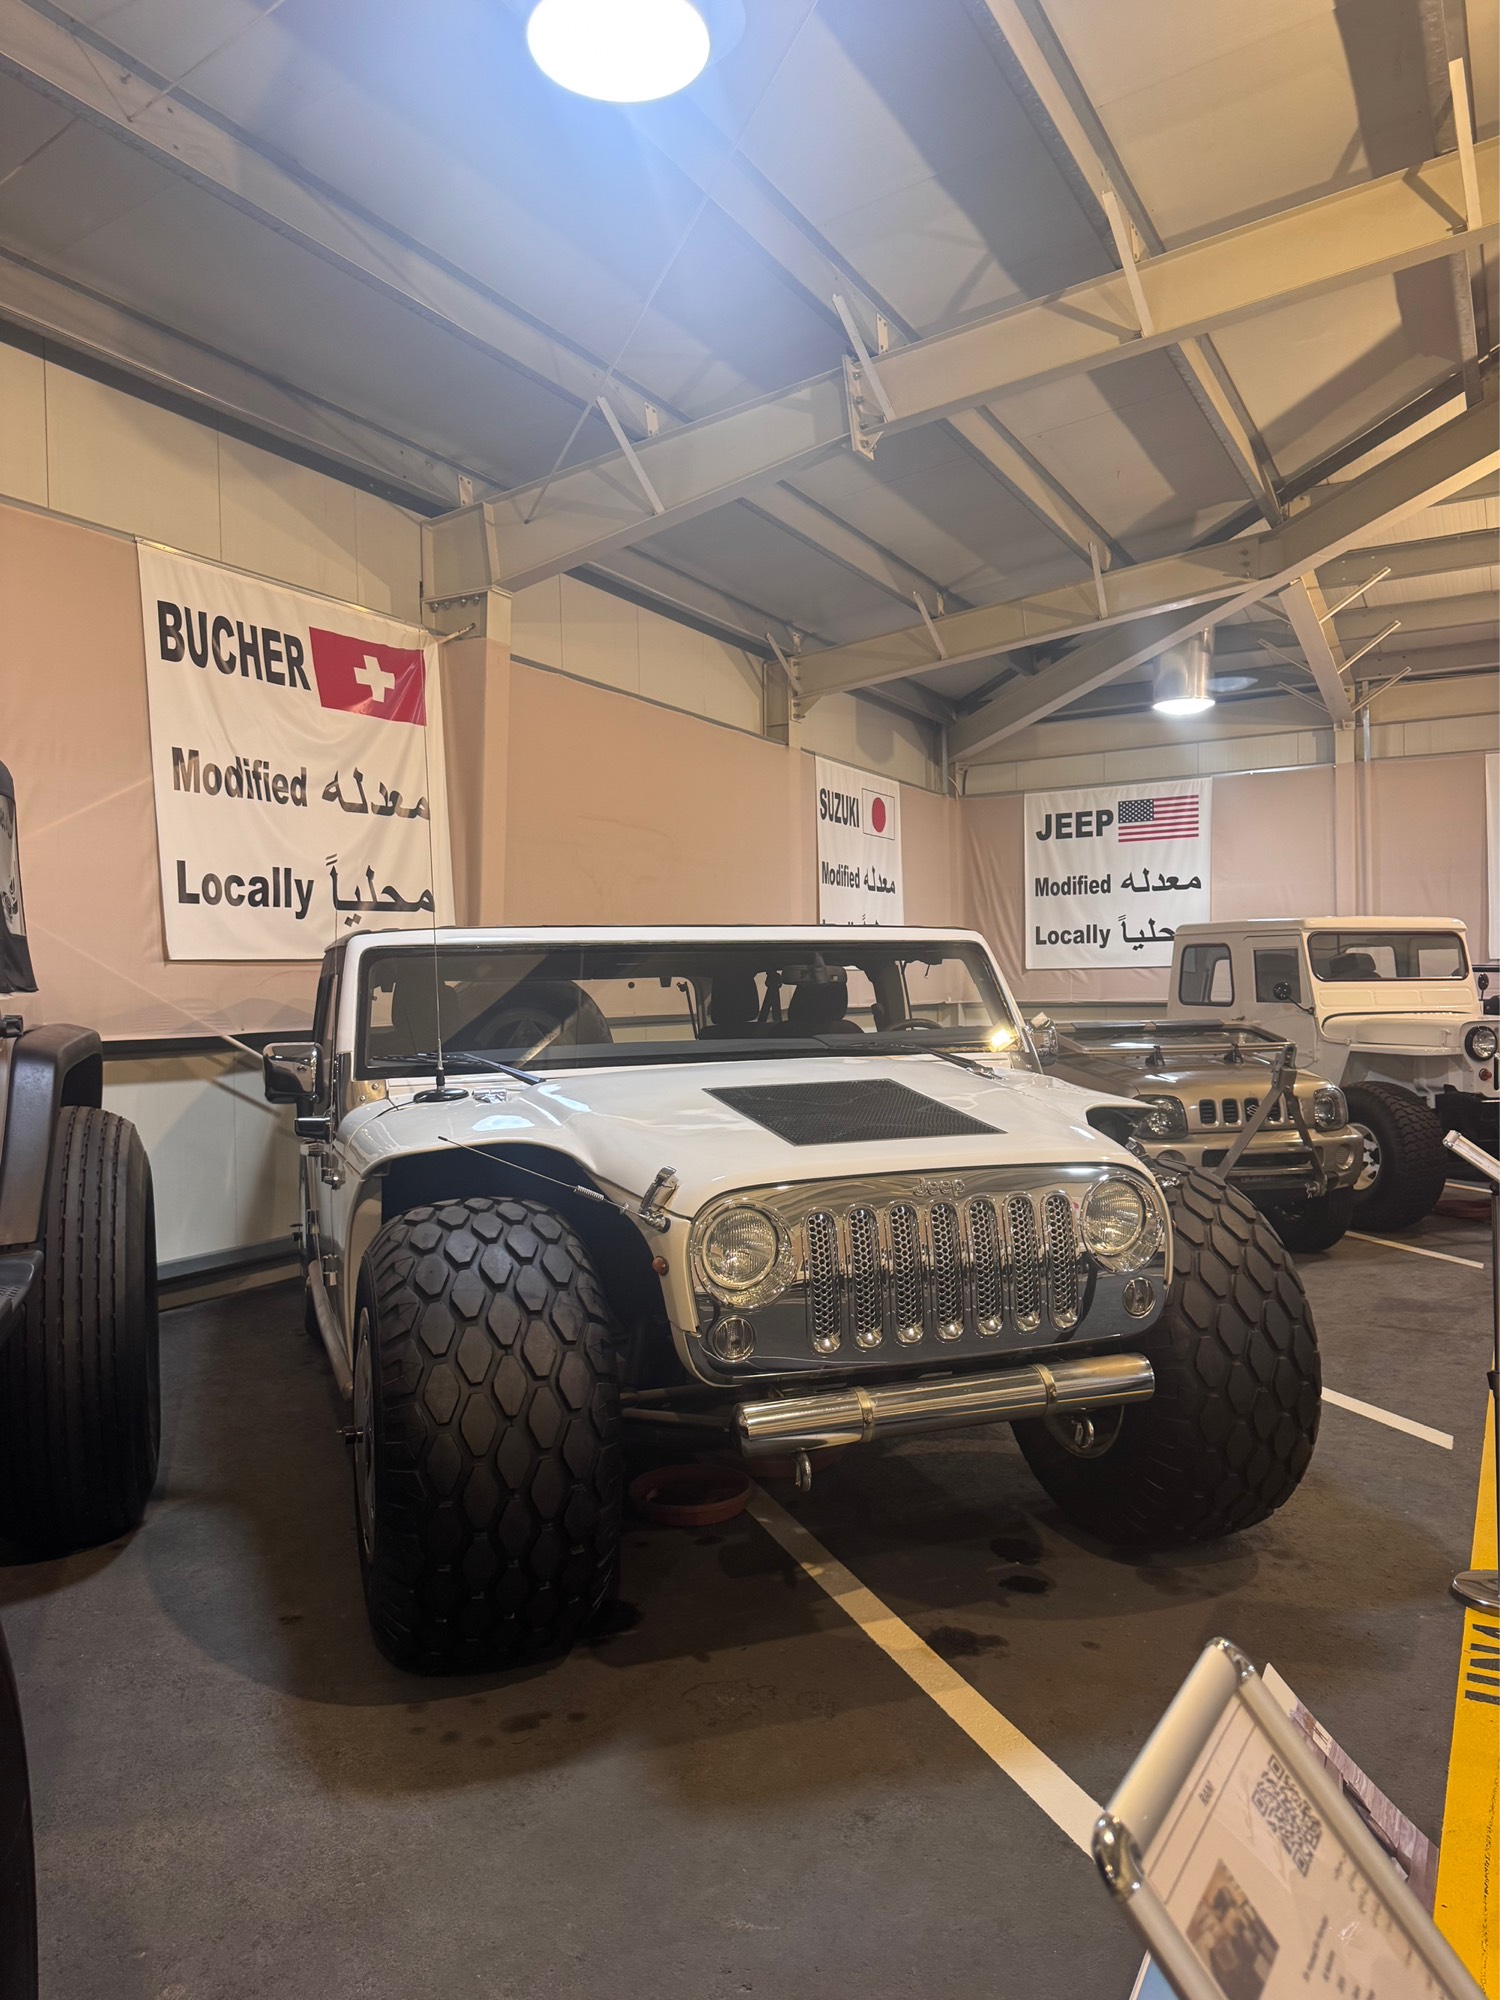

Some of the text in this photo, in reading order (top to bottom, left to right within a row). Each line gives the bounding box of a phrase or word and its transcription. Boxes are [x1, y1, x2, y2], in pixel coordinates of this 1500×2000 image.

[157, 600, 311, 691] BUCHER
[171, 746, 308, 807] Modified
[321, 767, 431, 821] معدله
[819, 788, 860, 828] SUZUKI
[1036, 809, 1114, 841] JEEP
[176, 859, 315, 920] Locally
[821, 861, 861, 889] Modified
[863, 866, 896, 895] معدله
[1035, 873, 1111, 897] Modified
[1120, 867, 1202, 893] معدله
[1035, 924, 1111, 949] Locally
[1118, 914, 1175, 951] حلياً
[912, 1177, 965, 1197] Jeep
